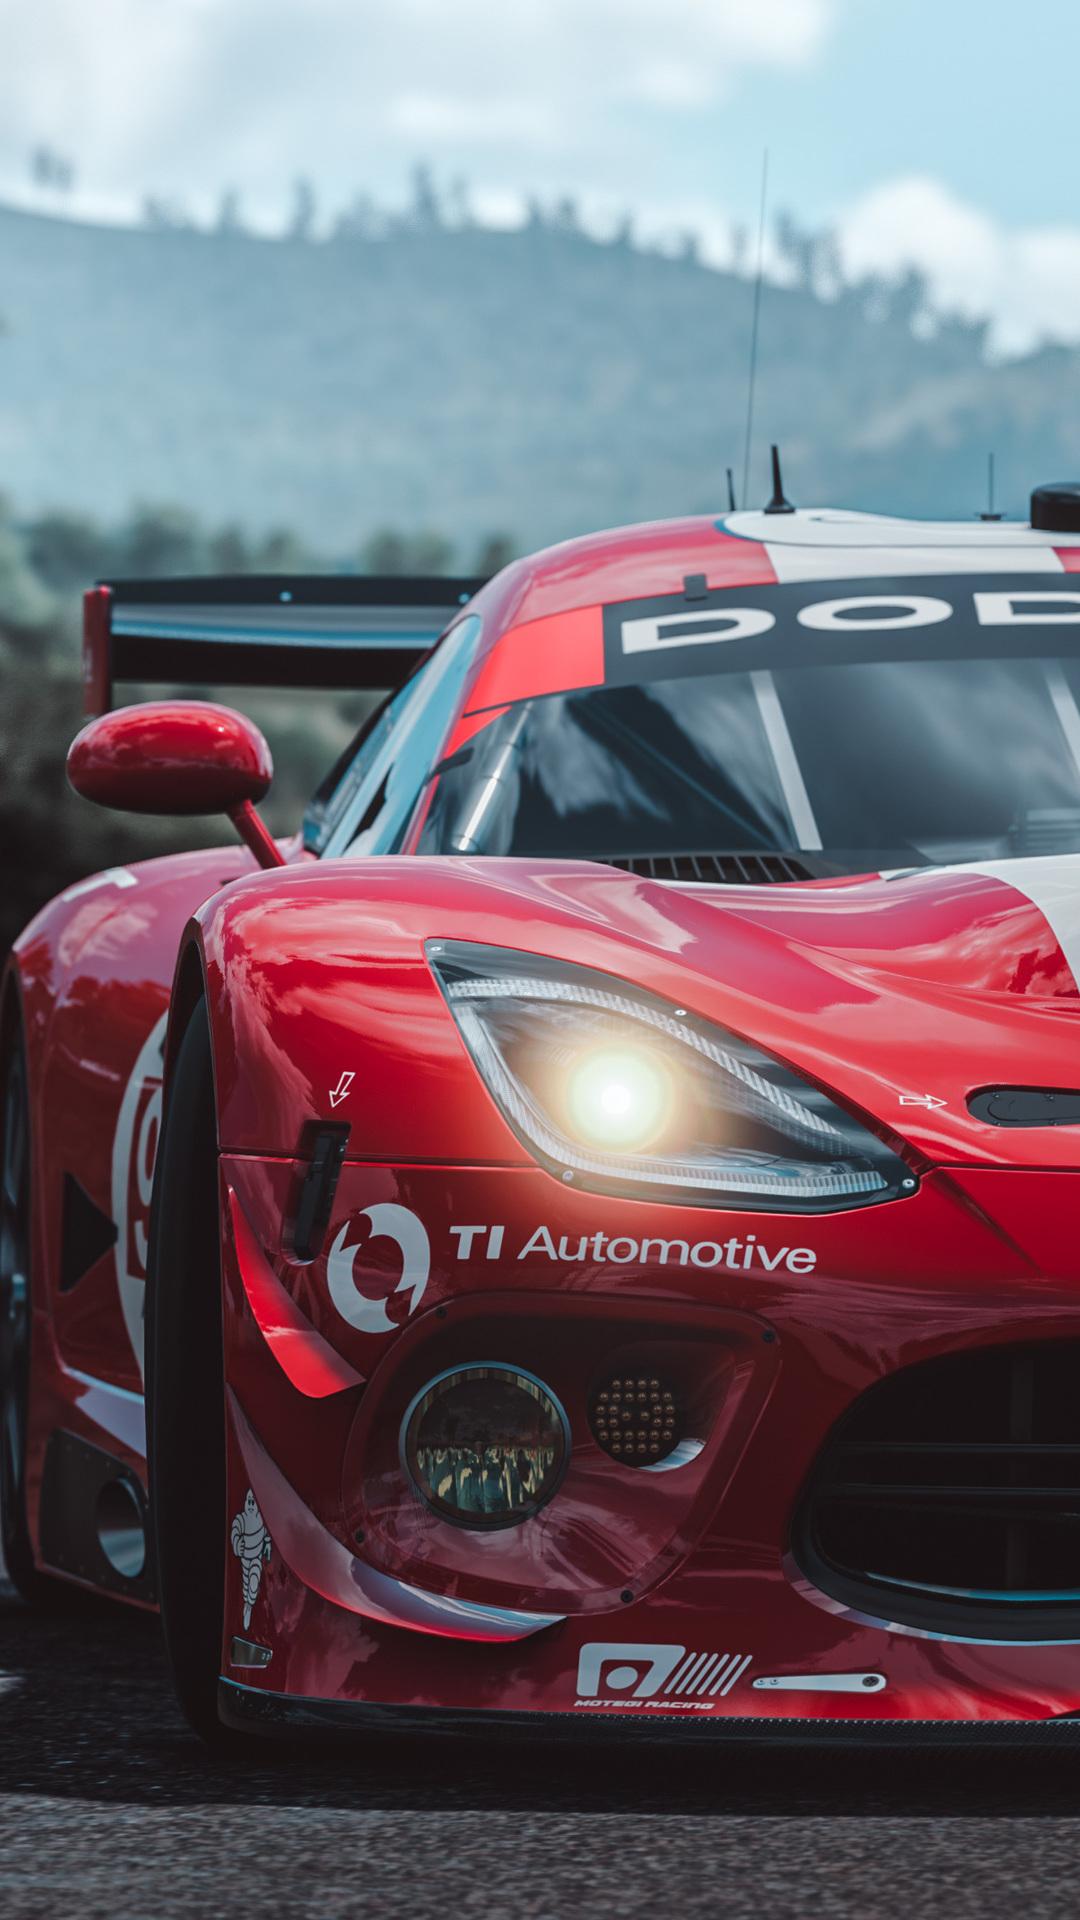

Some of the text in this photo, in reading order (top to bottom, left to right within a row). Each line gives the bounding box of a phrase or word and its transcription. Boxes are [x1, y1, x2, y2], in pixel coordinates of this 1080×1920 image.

[449, 1225, 818, 1274] TI Automotive
[574, 1700, 715, 1710] MOTEGI RACING
